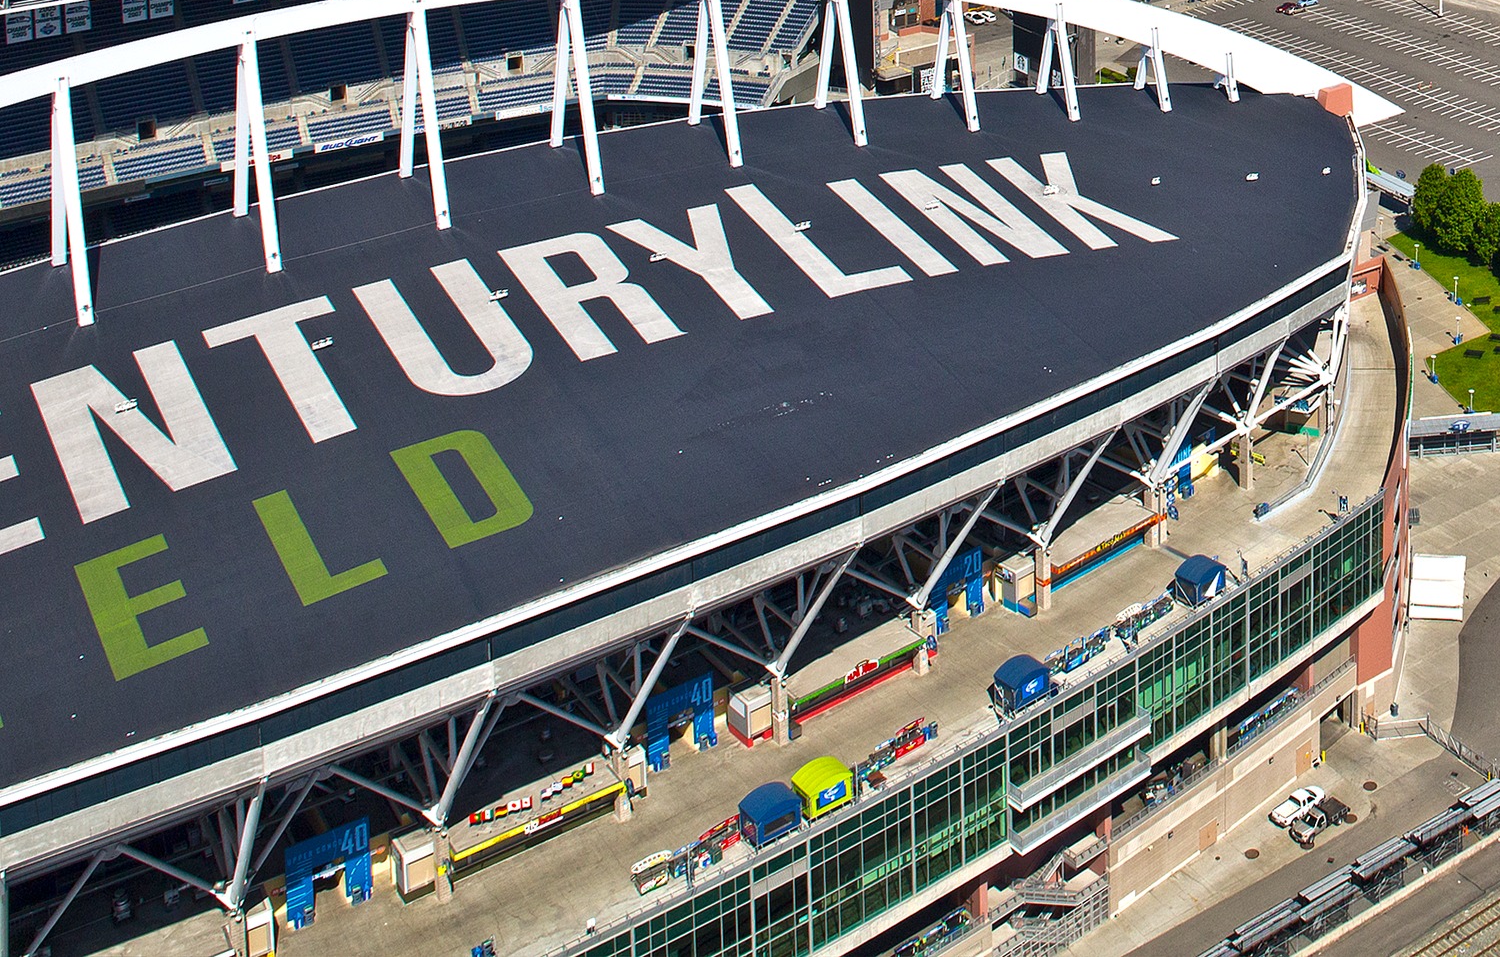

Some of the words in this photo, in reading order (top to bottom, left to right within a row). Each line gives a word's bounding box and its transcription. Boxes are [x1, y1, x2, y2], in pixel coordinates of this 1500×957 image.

[122, 4, 147, 14] CHAMPS
[150, 0, 173, 10] CHAMPS
[66, 14, 91, 24] CHAMPS
[6, 24, 32, 35] CHAMPS
[321, 140, 344, 152] BUD
[349, 134, 379, 147] LIGHT
[964, 550, 982, 578] 20
[691, 677, 712, 706] 40
[341, 823, 369, 855] 40
